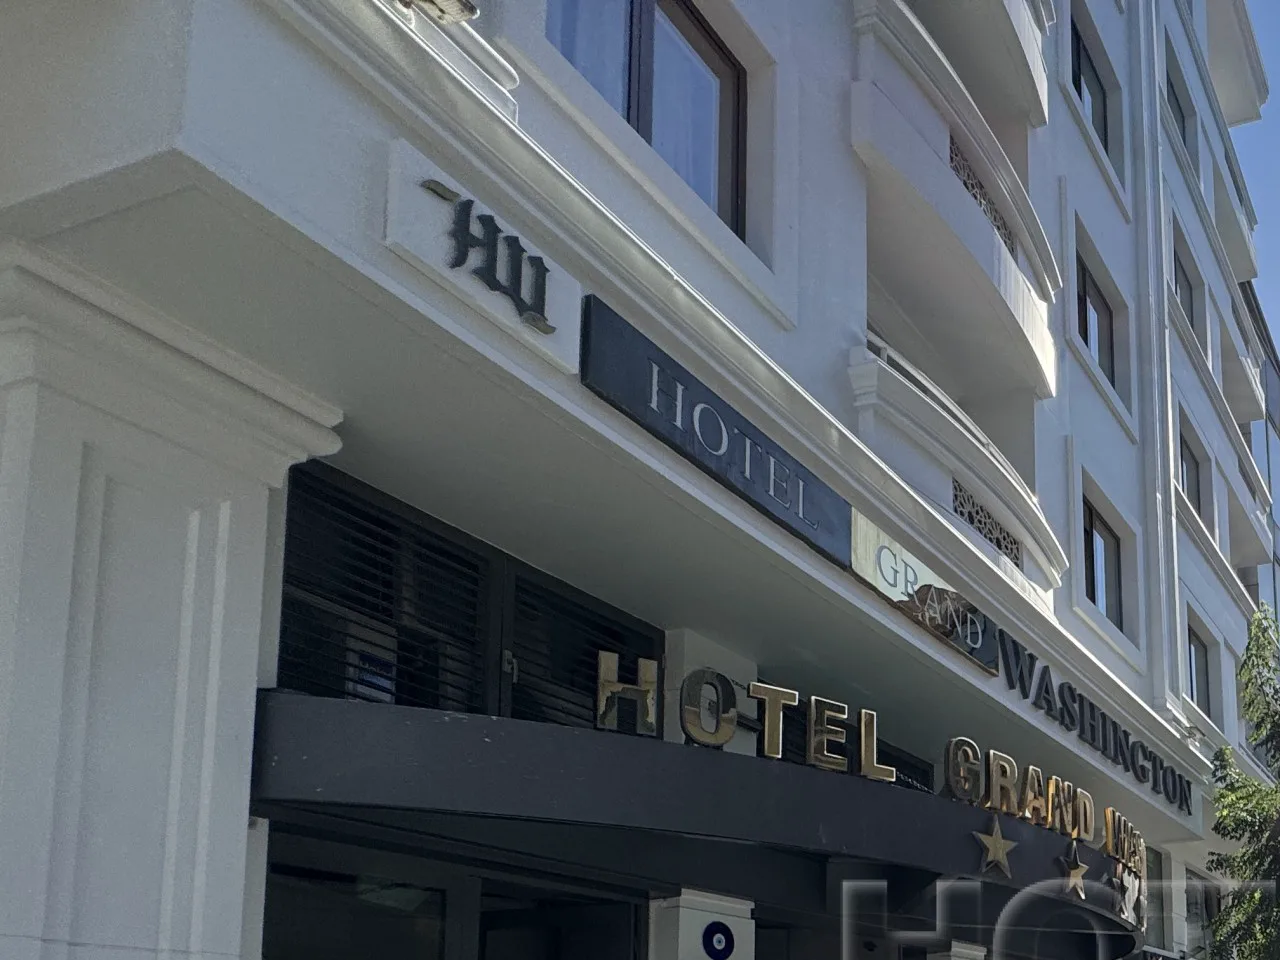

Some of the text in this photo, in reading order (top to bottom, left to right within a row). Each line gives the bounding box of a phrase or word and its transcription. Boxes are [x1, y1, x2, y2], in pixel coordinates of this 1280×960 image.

[596, 649, 898, 784] HOTEL
[944, 736, 1095, 843] GRAND
[648, 356, 1194, 817] HOTEL GRAND WASHINGTON
